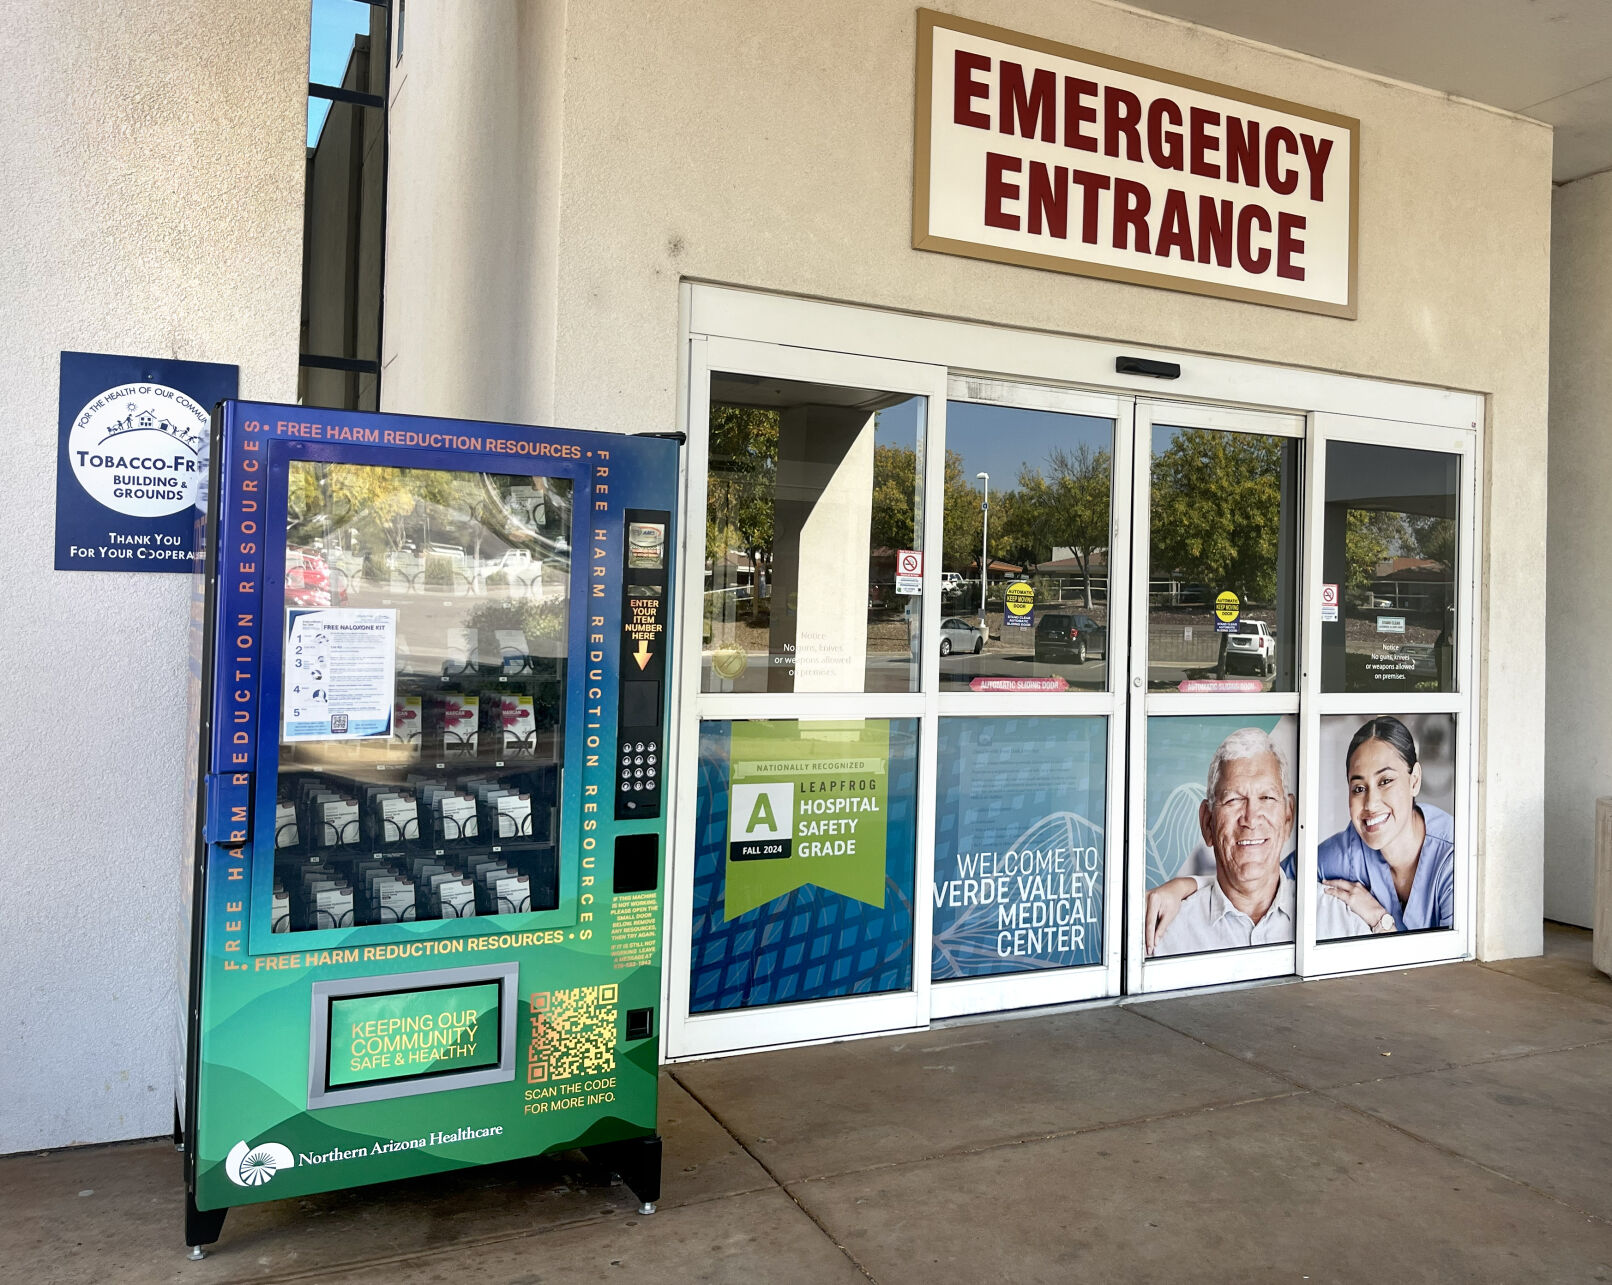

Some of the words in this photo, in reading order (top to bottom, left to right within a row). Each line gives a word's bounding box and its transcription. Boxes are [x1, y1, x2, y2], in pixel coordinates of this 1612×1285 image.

[953, 49, 1334, 202] EMERGENCY
[984, 151, 1307, 281] ENTRANCE
[77, 411, 93, 429] FOR
[90, 399, 106, 416] THE
[105, 387, 136, 405] HEALTH
[138, 386, 151, 394] OF
[154, 388, 174, 399] OUR
[277, 420, 323, 439] FREE
[327, 424, 380, 443] HARM
[384, 428, 482, 450] REDUCTION
[486, 437, 582, 459] RESOURCES
[77, 451, 196, 472] TOBACCO-FR
[113, 475, 178, 488] BUILDING
[595, 450, 610, 511] FREE
[113, 488, 184, 501] GROUNDS
[238, 420, 260, 593] RESOURCES
[109, 532, 151, 545] THANK
[154, 534, 181, 545] YOU
[70, 546, 98, 558] FOR
[99, 547, 133, 559] YOUR
[592, 529, 607, 597] HARM
[630, 599, 659, 608] ENTER
[633, 608, 657, 616] YOUR
[625, 624, 662, 632] NUMBER
[632, 632, 655, 640] HERE
[295, 646, 303, 655] 2
[783, 643, 796, 652] No
[295, 659, 302, 668] 3
[293, 685, 300, 693] 4
[585, 616, 604, 767] REDUCTION
[980, 680, 1016, 689] AUTOMATIC
[1017, 680, 1041, 689] SLIDING
[1042, 680, 1059, 689] DOOR
[232, 614, 254, 785] REDUCTION
[293, 708, 300, 717] 5
[756, 763, 810, 772] NATIONALLY
[812, 761, 865, 771] RECOGNIZED
[800, 779, 877, 793] LEAPFROG
[745, 792, 778, 833] A
[800, 797, 879, 815] HOSPITAL
[798, 819, 858, 837] SAFETY
[228, 806, 247, 880] HARM
[742, 846, 761, 855] FALL
[763, 845, 783, 854] 2024
[798, 839, 856, 858] GRADE
[579, 785, 598, 940] RESOURCES
[956, 848, 1066, 879] WELCOME
[1072, 846, 1098, 872] TO
[933, 877, 1010, 908] VERDE
[1017, 871, 1099, 902] VALLEY
[998, 898, 1097, 930] MEDICAL
[224, 901, 242, 970] FREE
[997, 925, 1085, 958] CENTER
[254, 952, 300, 972] FREE
[304, 948, 359, 968] HARM
[362, 938, 464, 962] REDUCTION
[466, 930, 564, 951] RESOURCES
[351, 1014, 434, 1039] KEEPING
[438, 1009, 477, 1027] OUR
[350, 1026, 478, 1056] COMMUNITY
[350, 1055, 391, 1072] SAFE
[394, 1053, 405, 1067] &
[408, 1042, 477, 1065] HEALTHY
[524, 1086, 557, 1100] SCAN
[560, 1082, 582, 1094] THE
[584, 1077, 616, 1091] CODE
[524, 1102, 548, 1116] FOR
[551, 1096, 584, 1111] MORE
[587, 1091, 616, 1105] INFO.
[298, 1147, 367, 1167] Northern
[372, 1136, 427, 1155] Arizona
[430, 1123, 503, 1148] Healthcare
